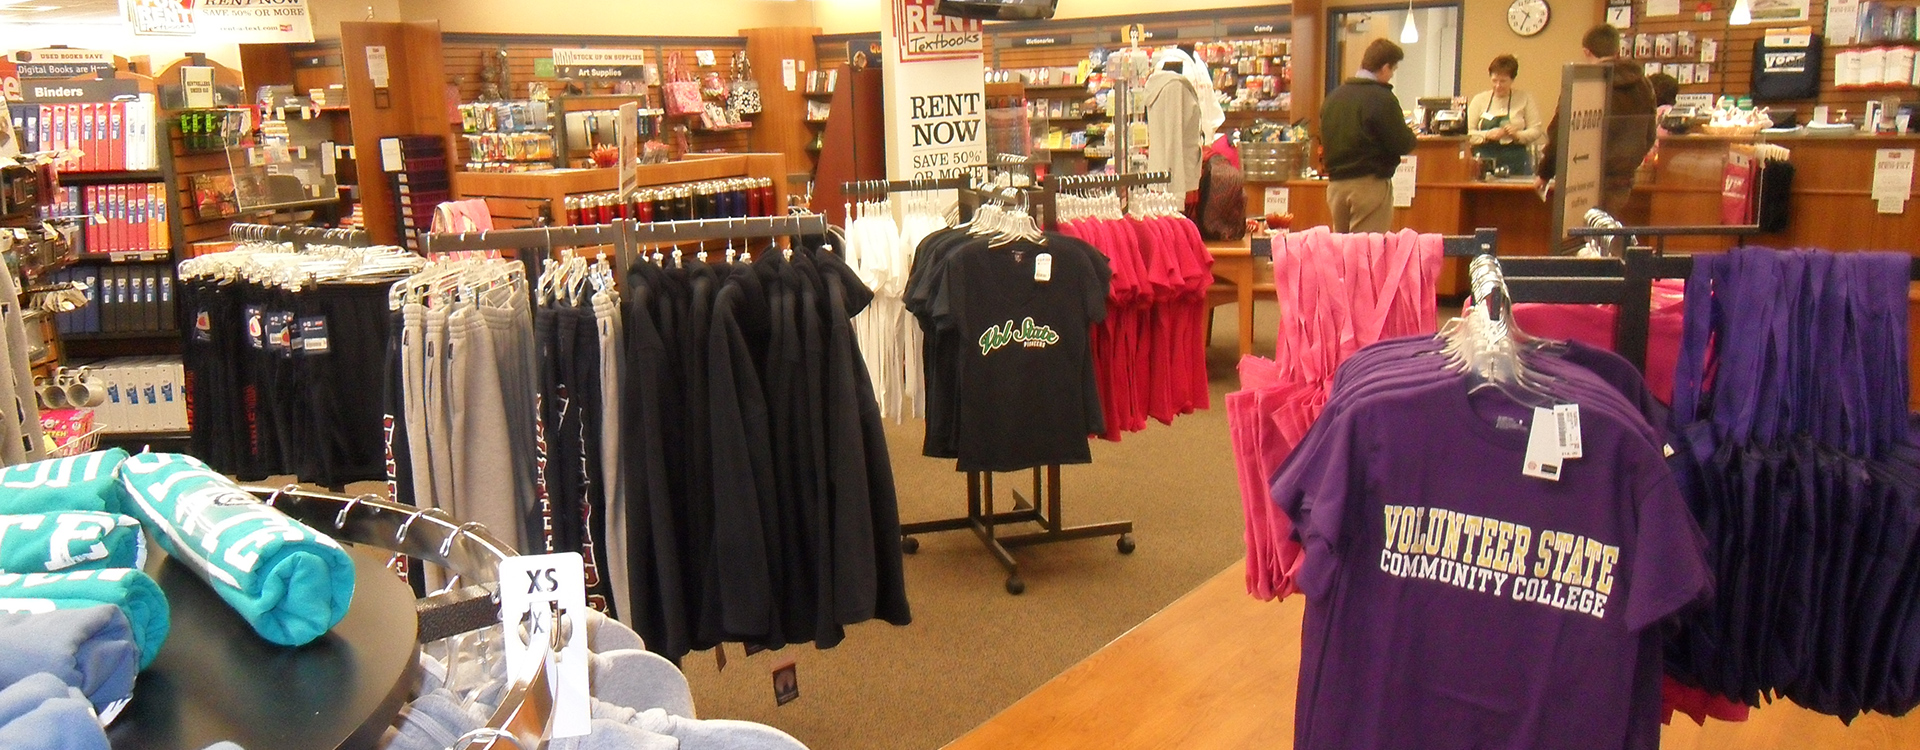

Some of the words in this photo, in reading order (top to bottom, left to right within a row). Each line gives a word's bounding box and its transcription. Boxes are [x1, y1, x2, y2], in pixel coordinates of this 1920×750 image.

[203, 8, 229, 17] SAVE
[254, 8, 271, 17] OR
[273, 8, 305, 17] MORE
[1615, 9, 1623, 20] 7
[1253, 25, 1273, 33] Candy
[910, 33, 980, 53] Textbooks
[18, 65, 47, 76] Digital
[49, 65, 74, 74] Books
[578, 68, 591, 77] Art
[591, 68, 621, 77] Supplies
[34, 86, 84, 98] Binders
[910, 92, 980, 119] RENT
[911, 118, 981, 147] NOW
[913, 152, 949, 169] SAVE
[979, 319, 1014, 355] Vol
[1012, 317, 1060, 345] State
[1384, 504, 1532, 575] VOLUNTEER
[1534, 529, 1620, 595] STATE
[525, 567, 559, 595] XS
[1380, 549, 1509, 597] COMMUNITY
[1511, 575, 1608, 619] COLLEGE
